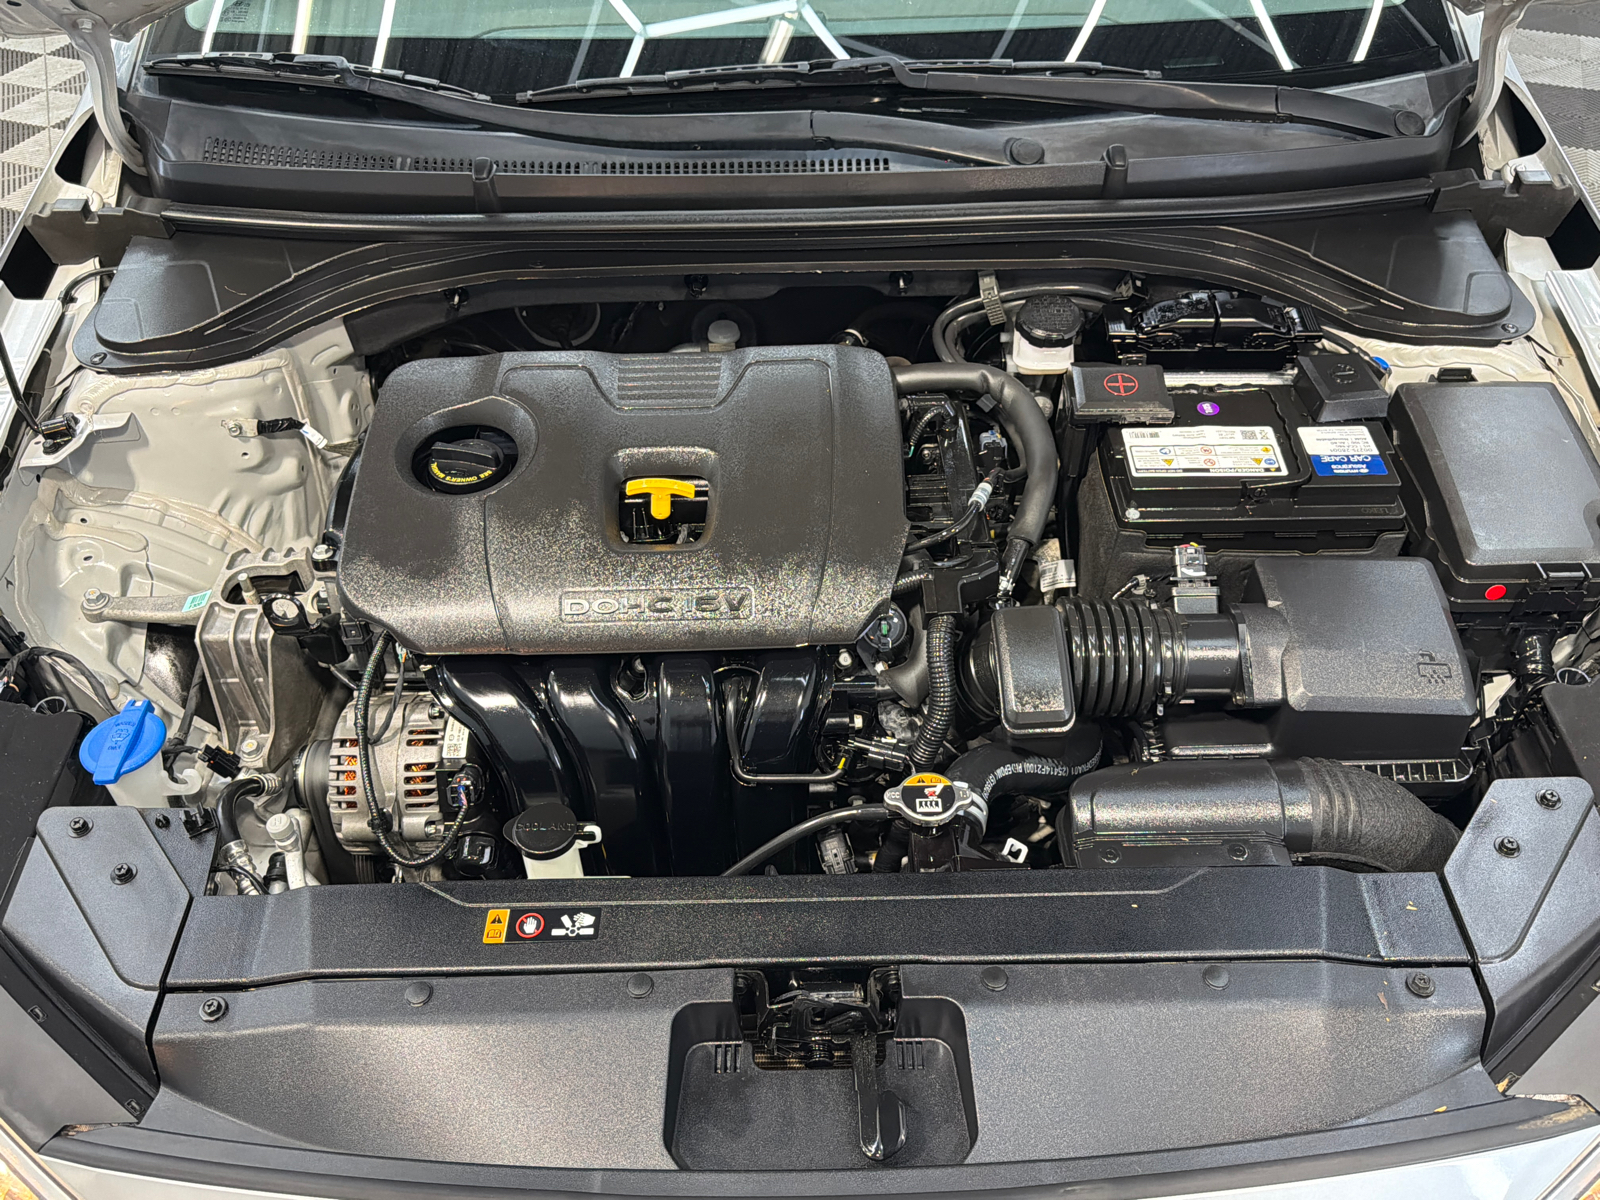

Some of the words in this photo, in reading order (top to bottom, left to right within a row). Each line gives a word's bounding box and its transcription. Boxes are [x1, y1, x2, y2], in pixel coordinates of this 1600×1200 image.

[1320, 455, 1348, 463] CARE
[430, 461, 446, 479] MANUAL
[479, 470, 493, 479] SEE
[564, 596, 673, 615] DOHC
[684, 593, 750, 613] 16V
[959, 790, 970, 798] 1.1
[516, 822, 575, 832] COOLANT
